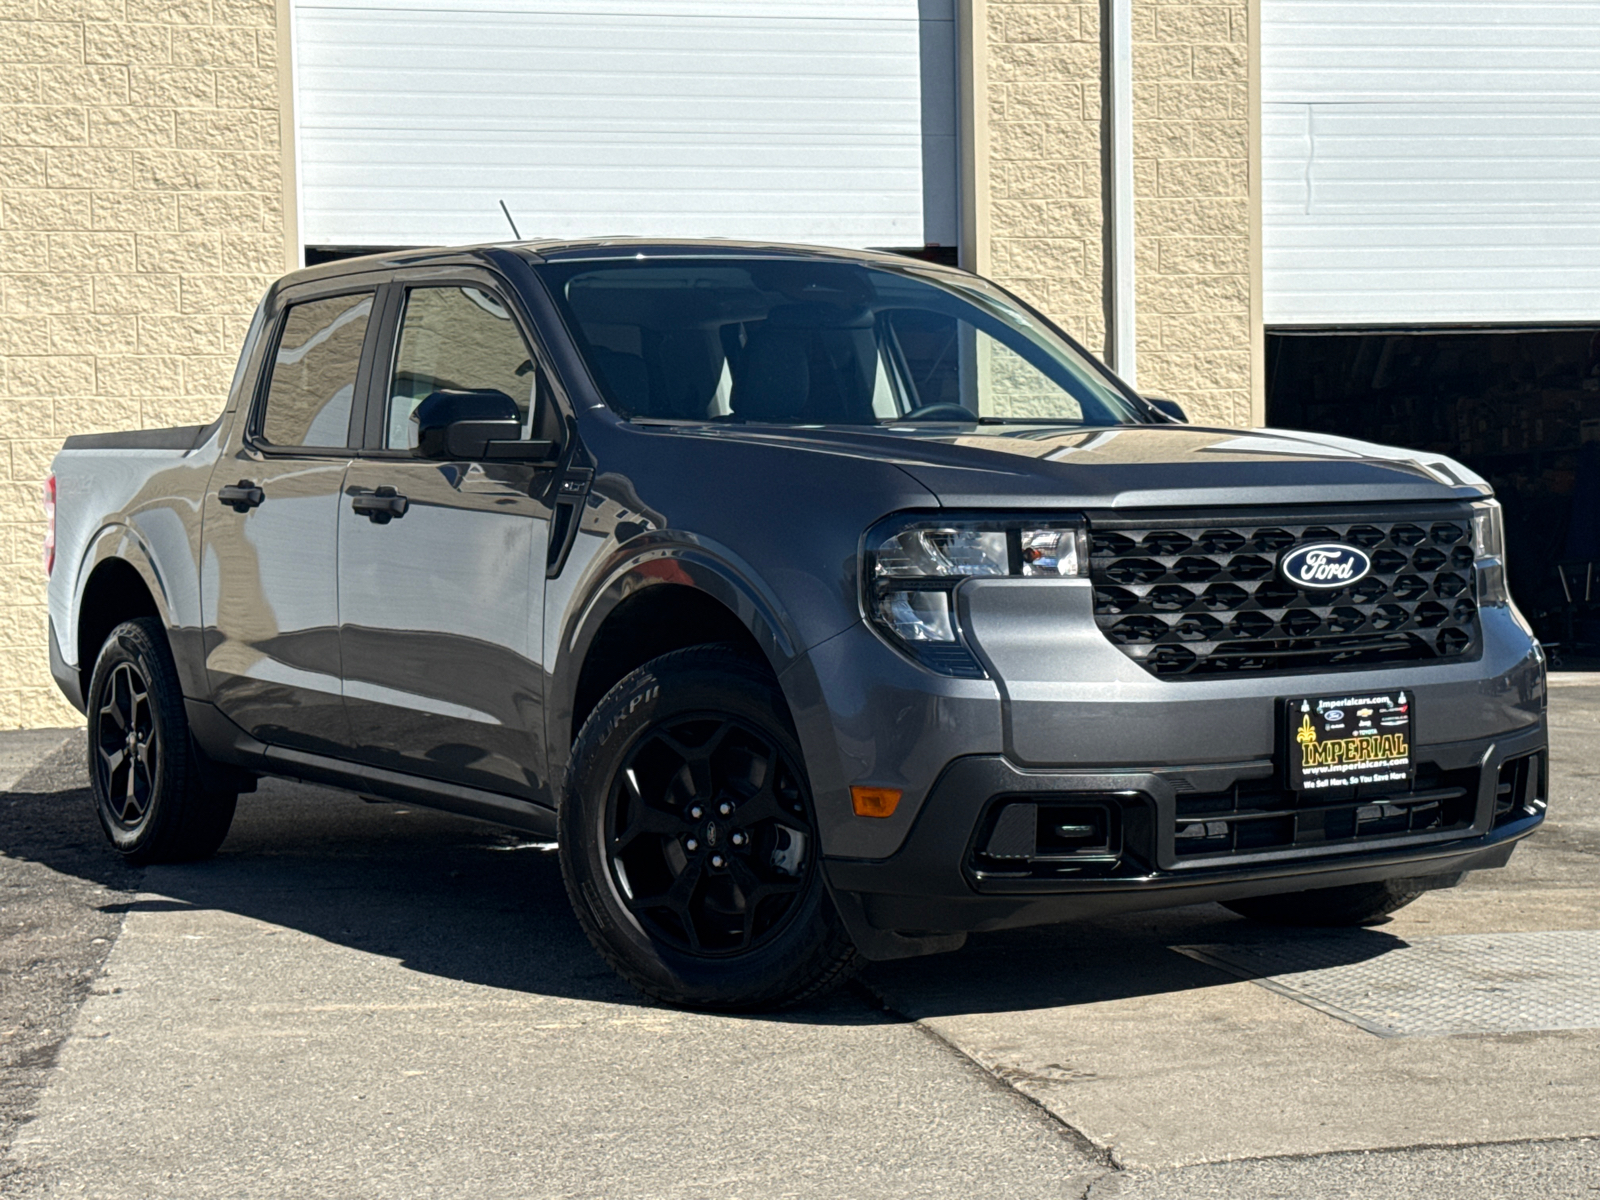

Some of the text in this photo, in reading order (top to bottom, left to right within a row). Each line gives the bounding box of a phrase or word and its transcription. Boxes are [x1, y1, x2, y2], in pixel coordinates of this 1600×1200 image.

[1301, 550, 1354, 580] Ford
[1302, 734, 1408, 766] IMPERIAL
[1303, 781, 1315, 789] We
[1316, 779, 1329, 787] Sell
[1350, 776, 1359, 784] So
[1360, 775, 1372, 783] You
[1373, 774, 1389, 782] Save
[1390, 772, 1406, 780] More
